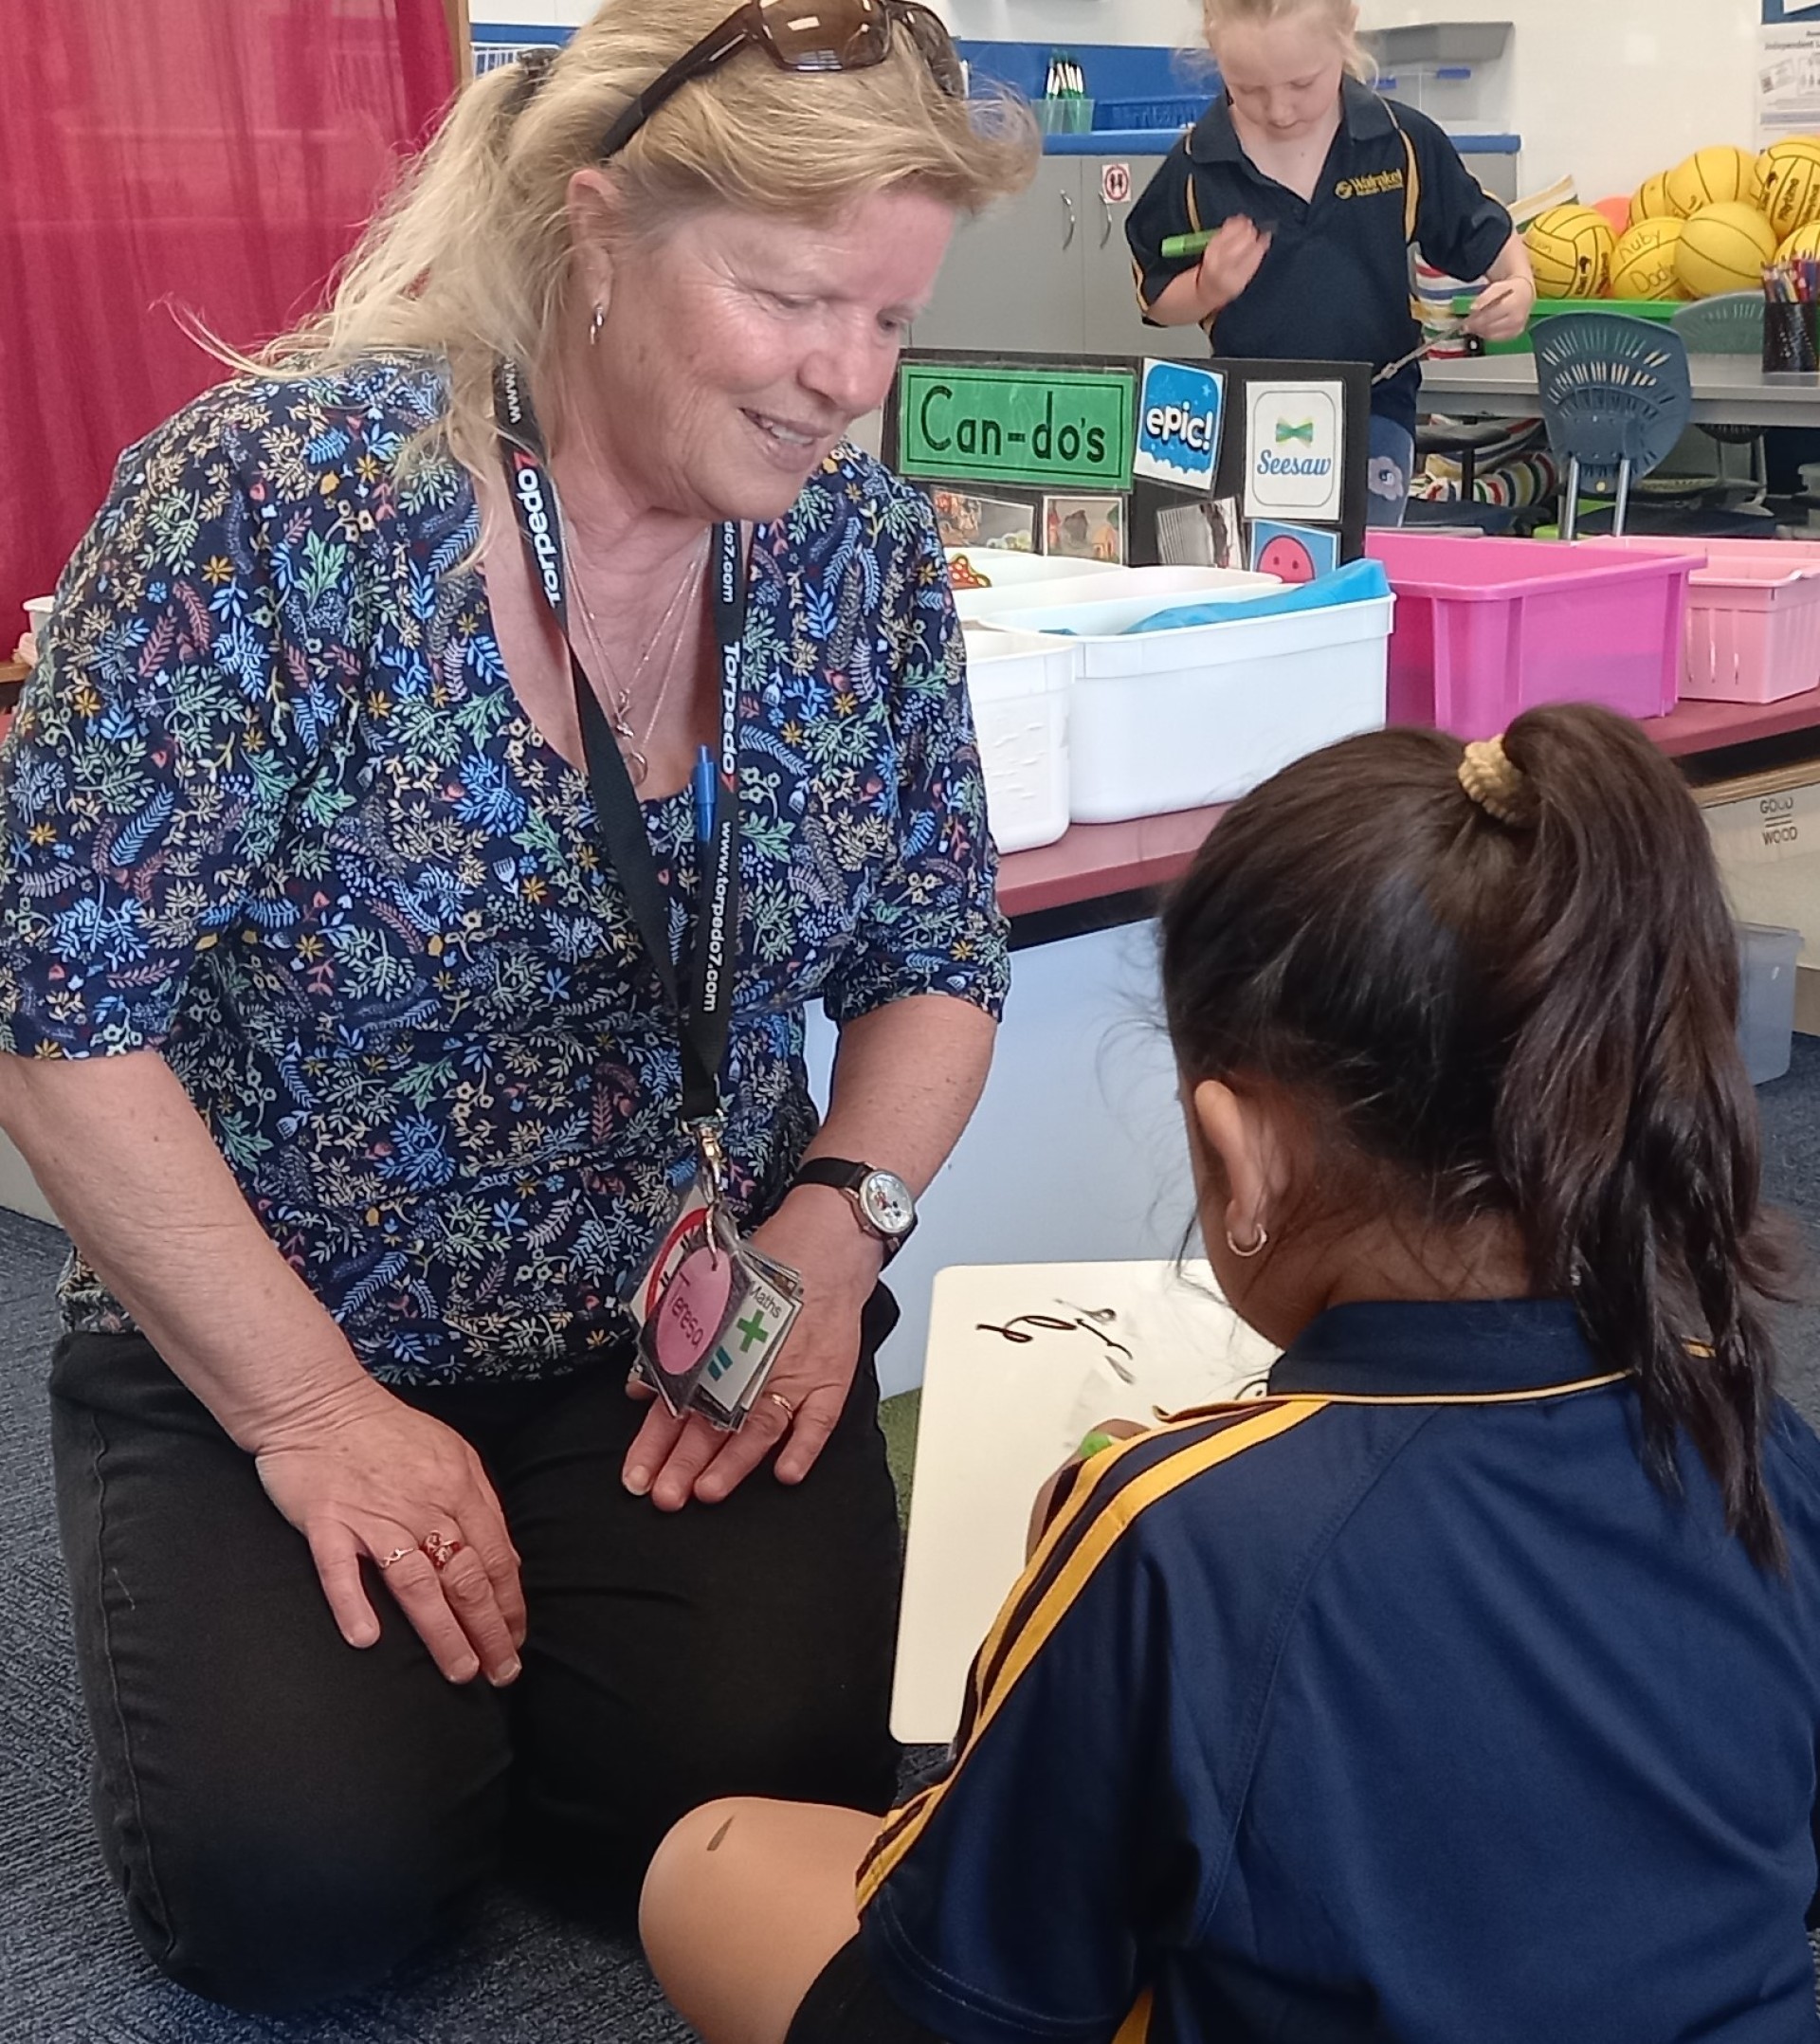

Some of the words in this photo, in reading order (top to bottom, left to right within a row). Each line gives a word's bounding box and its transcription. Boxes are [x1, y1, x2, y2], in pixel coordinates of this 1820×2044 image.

[920, 385, 1106, 464] Can-do's
[1145, 399, 1213, 453] epic!
[1256, 448, 1332, 477] Seesaw
[1762, 826, 1798, 846] WOOD
[703, 821, 732, 1012] www.torpedo7.com
[749, 1279, 783, 1320] Maths
